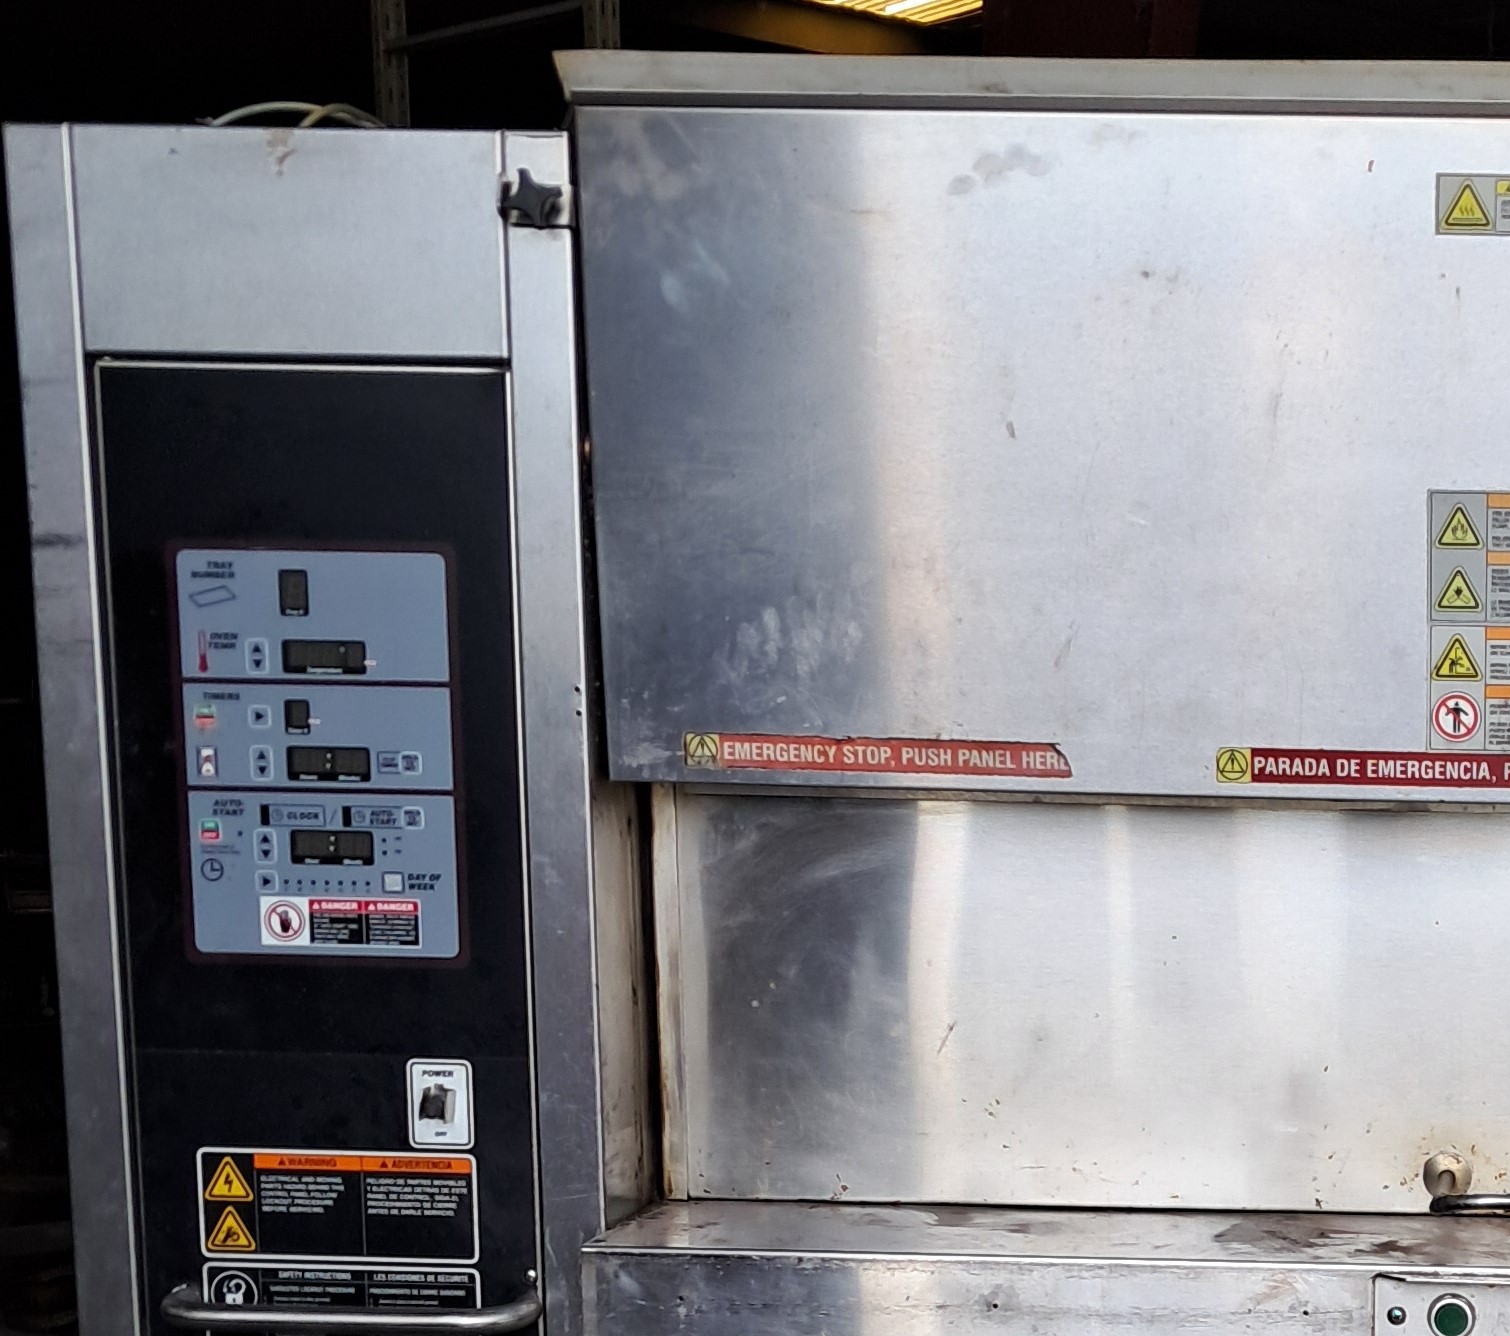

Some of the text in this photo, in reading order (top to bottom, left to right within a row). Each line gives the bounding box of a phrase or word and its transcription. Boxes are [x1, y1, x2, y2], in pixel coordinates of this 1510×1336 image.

[723, 741, 838, 764] EMERGENCY
[843, 746, 896, 768] STOP,
[901, 747, 952, 767] PUSH
[958, 749, 1016, 769] PANEL
[1253, 756, 1330, 777] PARADA
[1336, 758, 1361, 778] DE
[1367, 759, 1497, 783] EMERGENCIA,
[286, 811, 319, 820] CLOCK
[407, 874, 426, 882] DAY
[422, 1070, 454, 1078] POWER
[288, 1158, 337, 1167] WARNING
[392, 1160, 453, 1169] ADVERTENCIA
